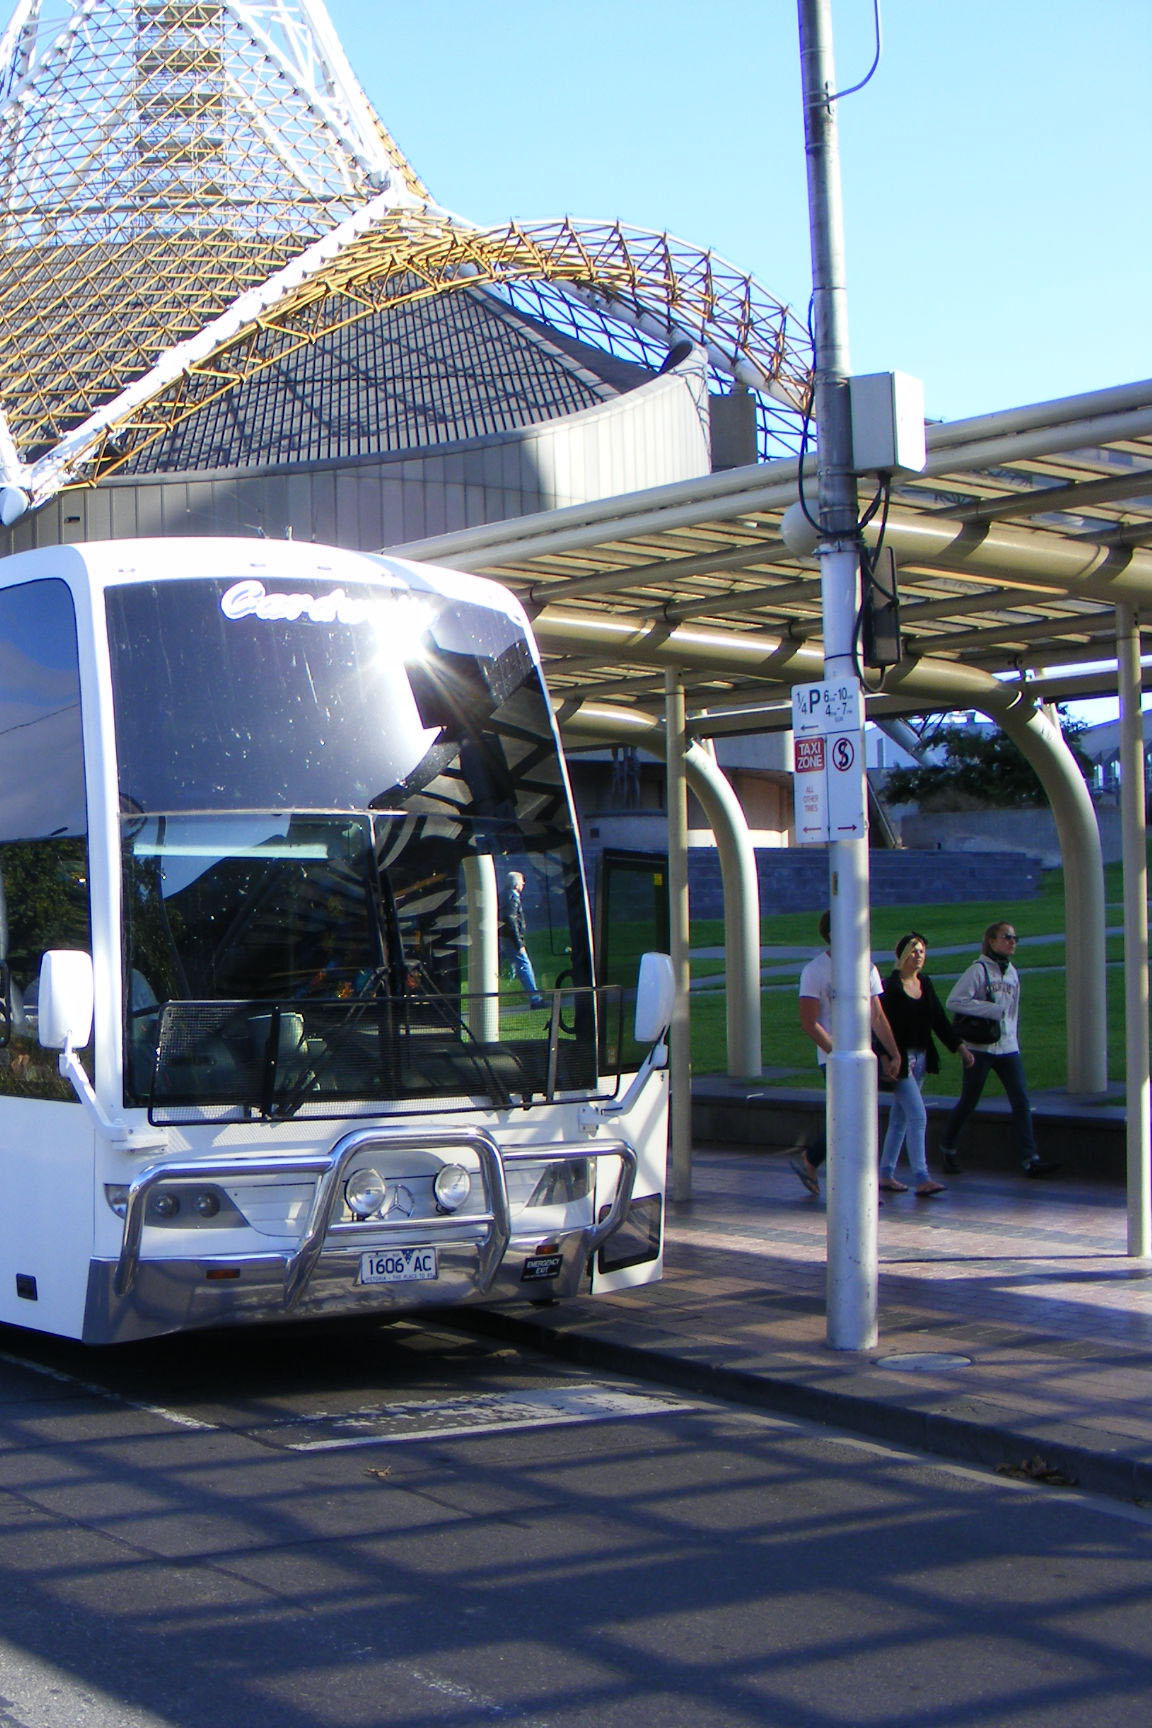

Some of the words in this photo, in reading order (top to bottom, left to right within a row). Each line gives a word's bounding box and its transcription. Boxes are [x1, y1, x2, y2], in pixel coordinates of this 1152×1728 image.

[809, 689, 821, 713] P
[824, 687, 853, 702] 6-10
[799, 741, 821, 755] TAXI
[797, 755, 823, 769] ZONE
[805, 785, 814, 793] ALL
[369, 1258, 404, 1275] 1606
[414, 1255, 432, 1272] AC
[527, 1258, 560, 1268] EMERGENCY
